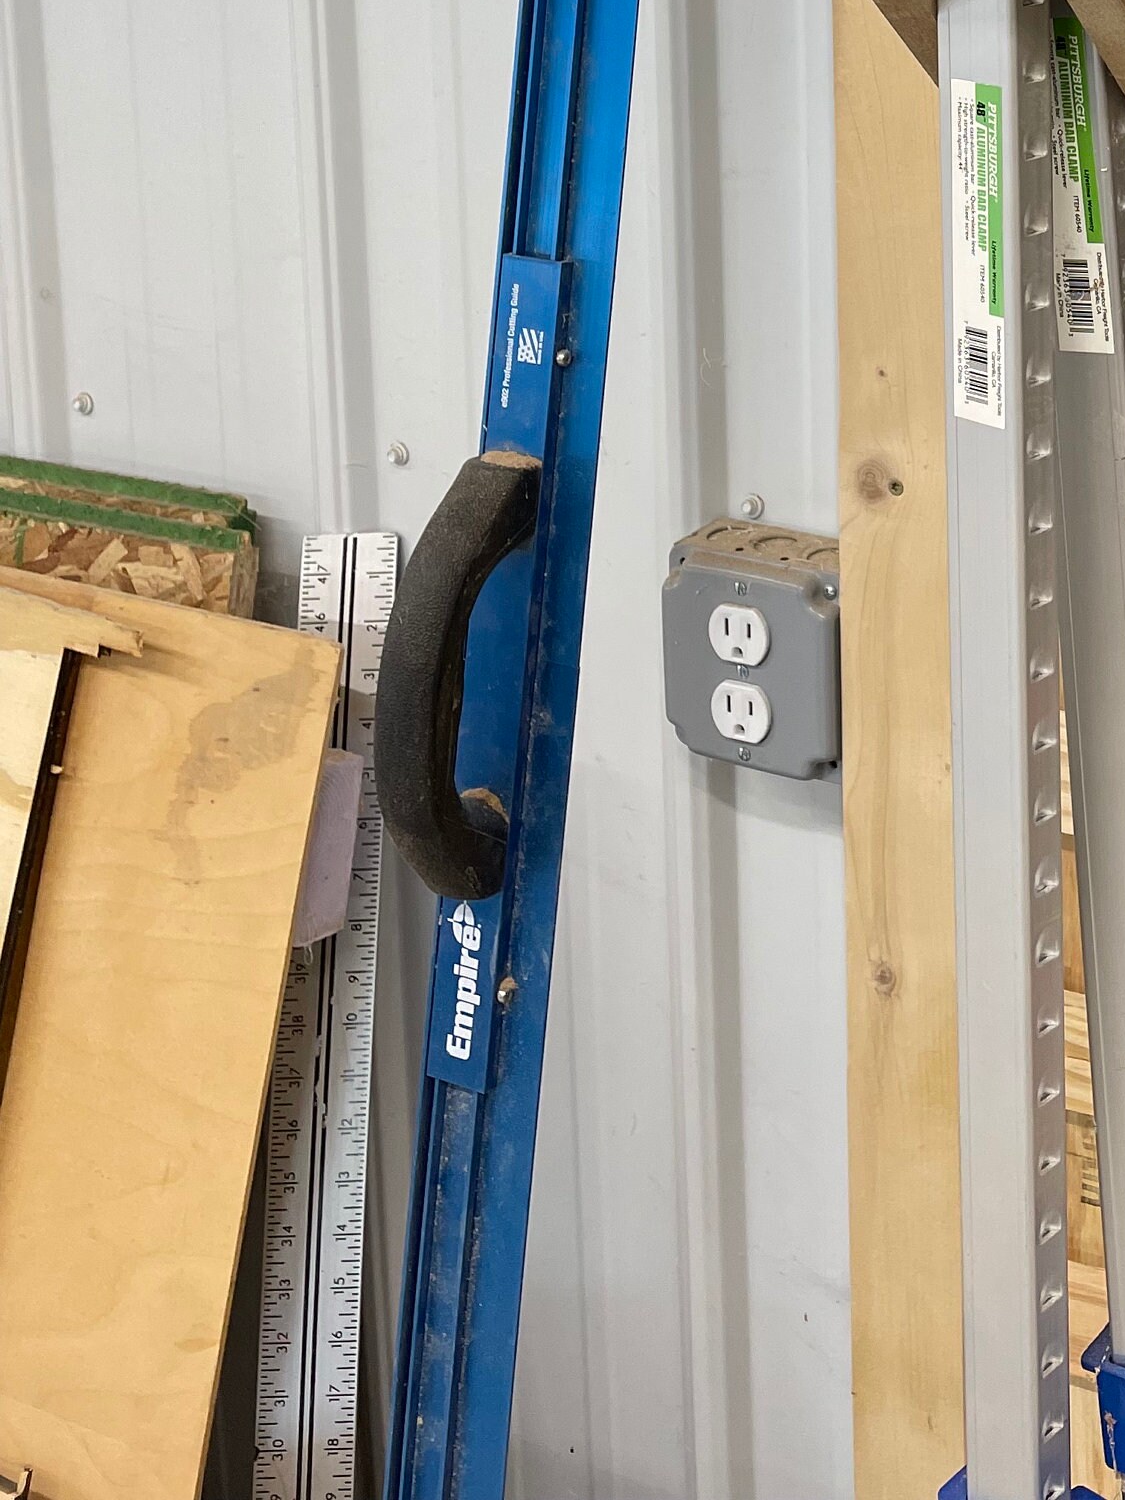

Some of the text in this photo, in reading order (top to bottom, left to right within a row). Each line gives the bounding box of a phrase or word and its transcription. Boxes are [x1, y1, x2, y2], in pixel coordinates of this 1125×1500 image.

[1058, 61, 1073, 119] ALUMINUM
[1068, 35, 1086, 127] PITTSBURGH
[1065, 122, 1075, 143] BAR
[976, 127, 986, 187] ALUMINUM
[988, 102, 998, 198] PITTSBURGH
[1057, 129, 1066, 171] Quick-release
[1066, 146, 1079, 182] CLAMP
[977, 189, 987, 211] BAR
[1083, 170, 1095, 232] Lifetime Warranty
[1073, 196, 1082, 233] ITEM 60540
[978, 214, 987, 252] CLAMP
[511, 283, 520, 306] Guide
[508, 308, 518, 337] Cutting
[502, 338, 513, 387] Professional
[317, 564, 328, 584] 47
[315, 612, 326, 632] 46
[366, 622, 378, 632] 2
[364, 671, 375, 680] 3
[362, 720, 372, 729] 4
[359, 819, 368, 830] 6
[353, 872, 364, 881] 7
[351, 921, 362, 932] 8
[348, 972, 359, 984] 9
[446, 925, 481, 1060] Empire
[293, 1015, 303, 1036] 38
[346, 1012, 357, 1031] 10
[290, 1067, 300, 1088] 37
[343, 1070, 355, 1082] 11
[288, 1119, 298, 1141] 36
[341, 1118, 353, 1136] 12
[284, 1172, 295, 1193] 35
[338, 1171, 350, 1188] 13
[282, 1226, 293, 1247] 34
[335, 1224, 347, 1242] 14
[279, 1279, 291, 1300] 33
[334, 1277, 345, 1296] 15
[277, 1332, 289, 1353] 32
[331, 1330, 343, 1348] 16
[273, 1389, 286, 1408] 31
[328, 1384, 341, 1403] 17
[272, 1439, 284, 1462] 30
[327, 1438, 339, 1457] 18
